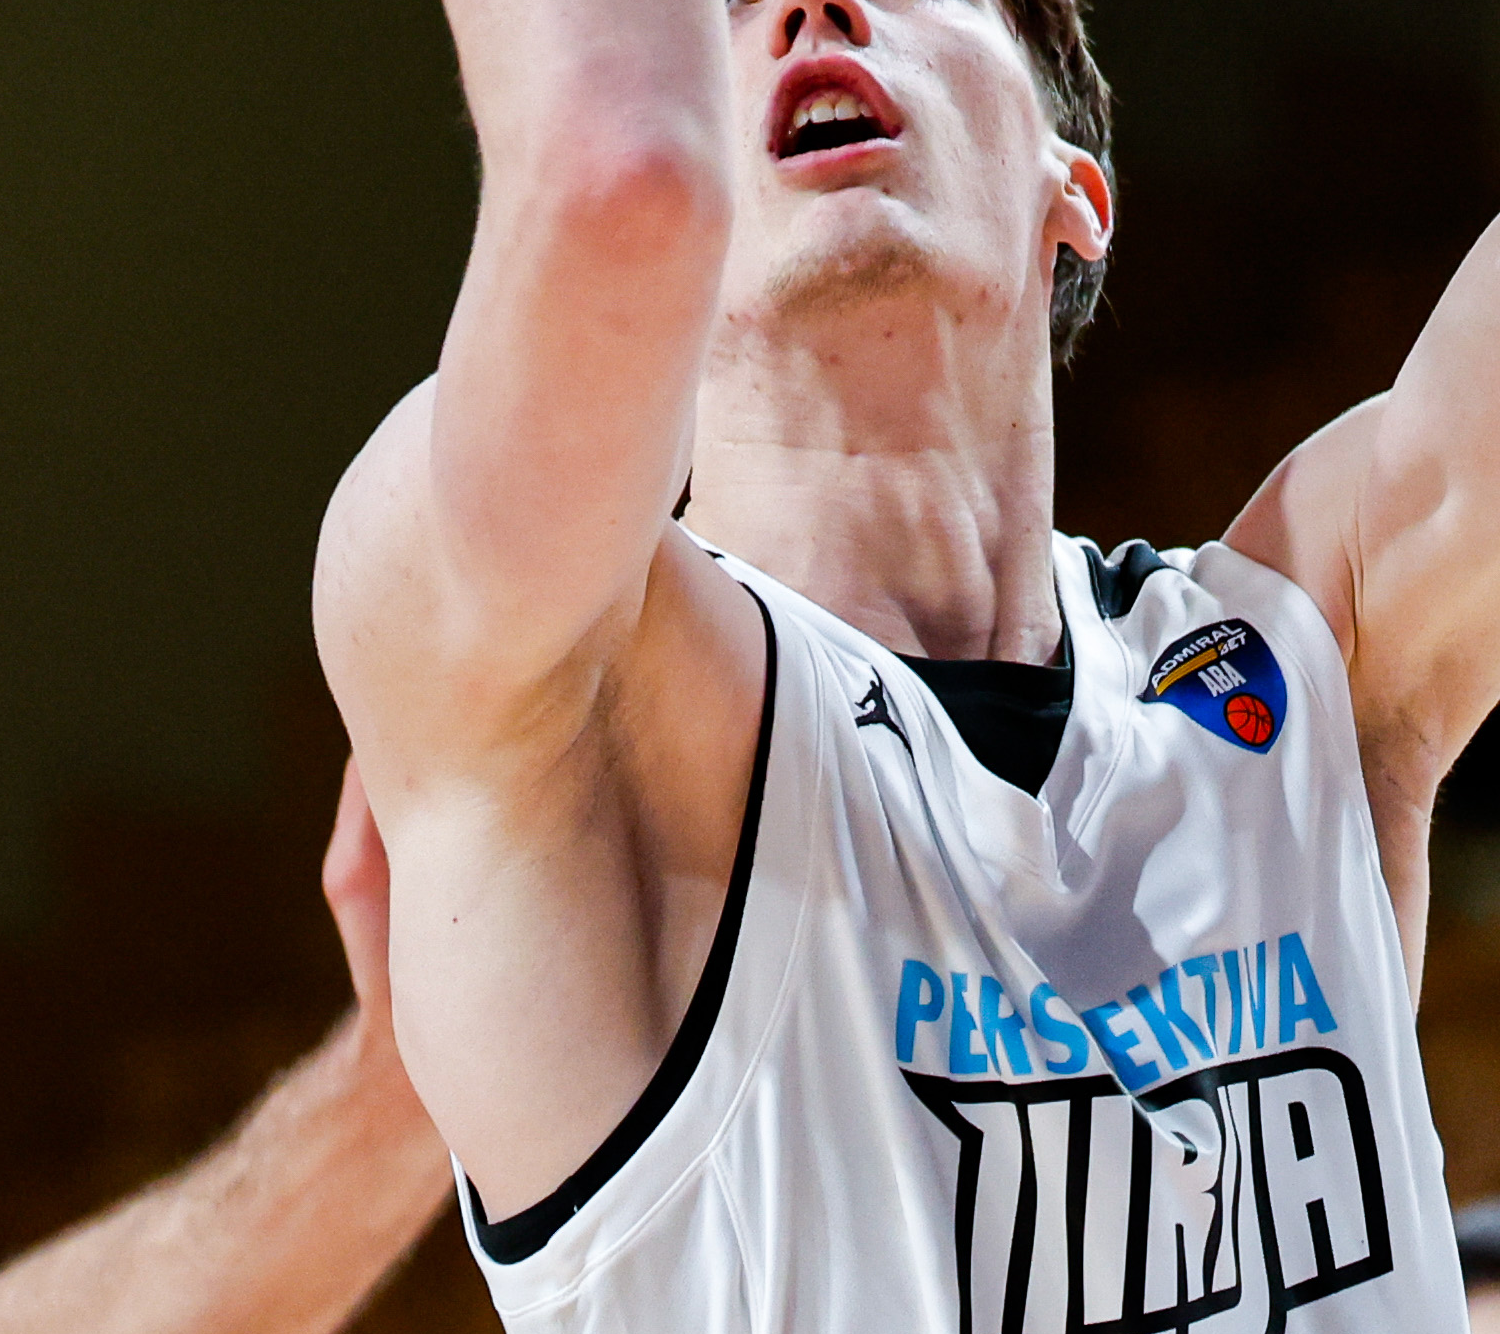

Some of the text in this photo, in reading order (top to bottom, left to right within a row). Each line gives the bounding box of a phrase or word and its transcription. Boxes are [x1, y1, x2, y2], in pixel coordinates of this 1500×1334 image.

[1151, 624, 1242, 689] ADMIRAL
[1218, 631, 1247, 656] BET
[1198, 660, 1247, 698] ABA
